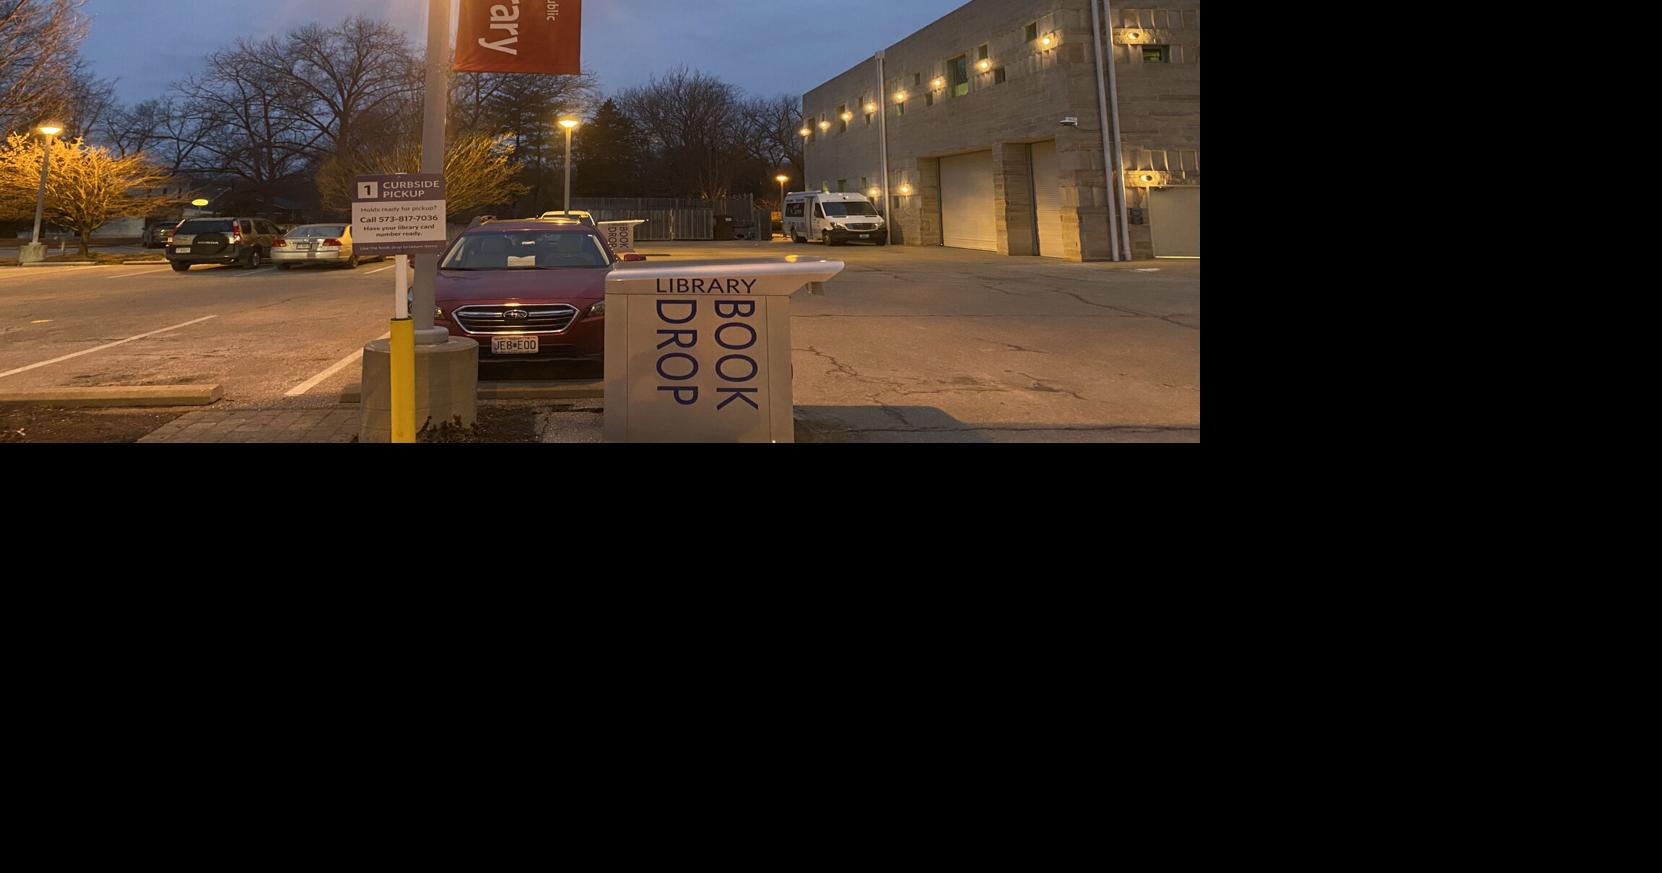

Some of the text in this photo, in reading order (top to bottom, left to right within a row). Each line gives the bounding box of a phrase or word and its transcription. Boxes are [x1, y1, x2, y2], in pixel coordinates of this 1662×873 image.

[363, 184, 371, 196] 1
[382, 180, 440, 189] CURBSIDE
[382, 190, 425, 198] PICKUP
[378, 215, 439, 223] 573-817-7036
[607, 226, 617, 249] DROP
[619, 226, 629, 249] BOOK
[656, 278, 758, 294] LIBRARY
[656, 299, 699, 406] DROP
[714, 300, 759, 411] BOOK
